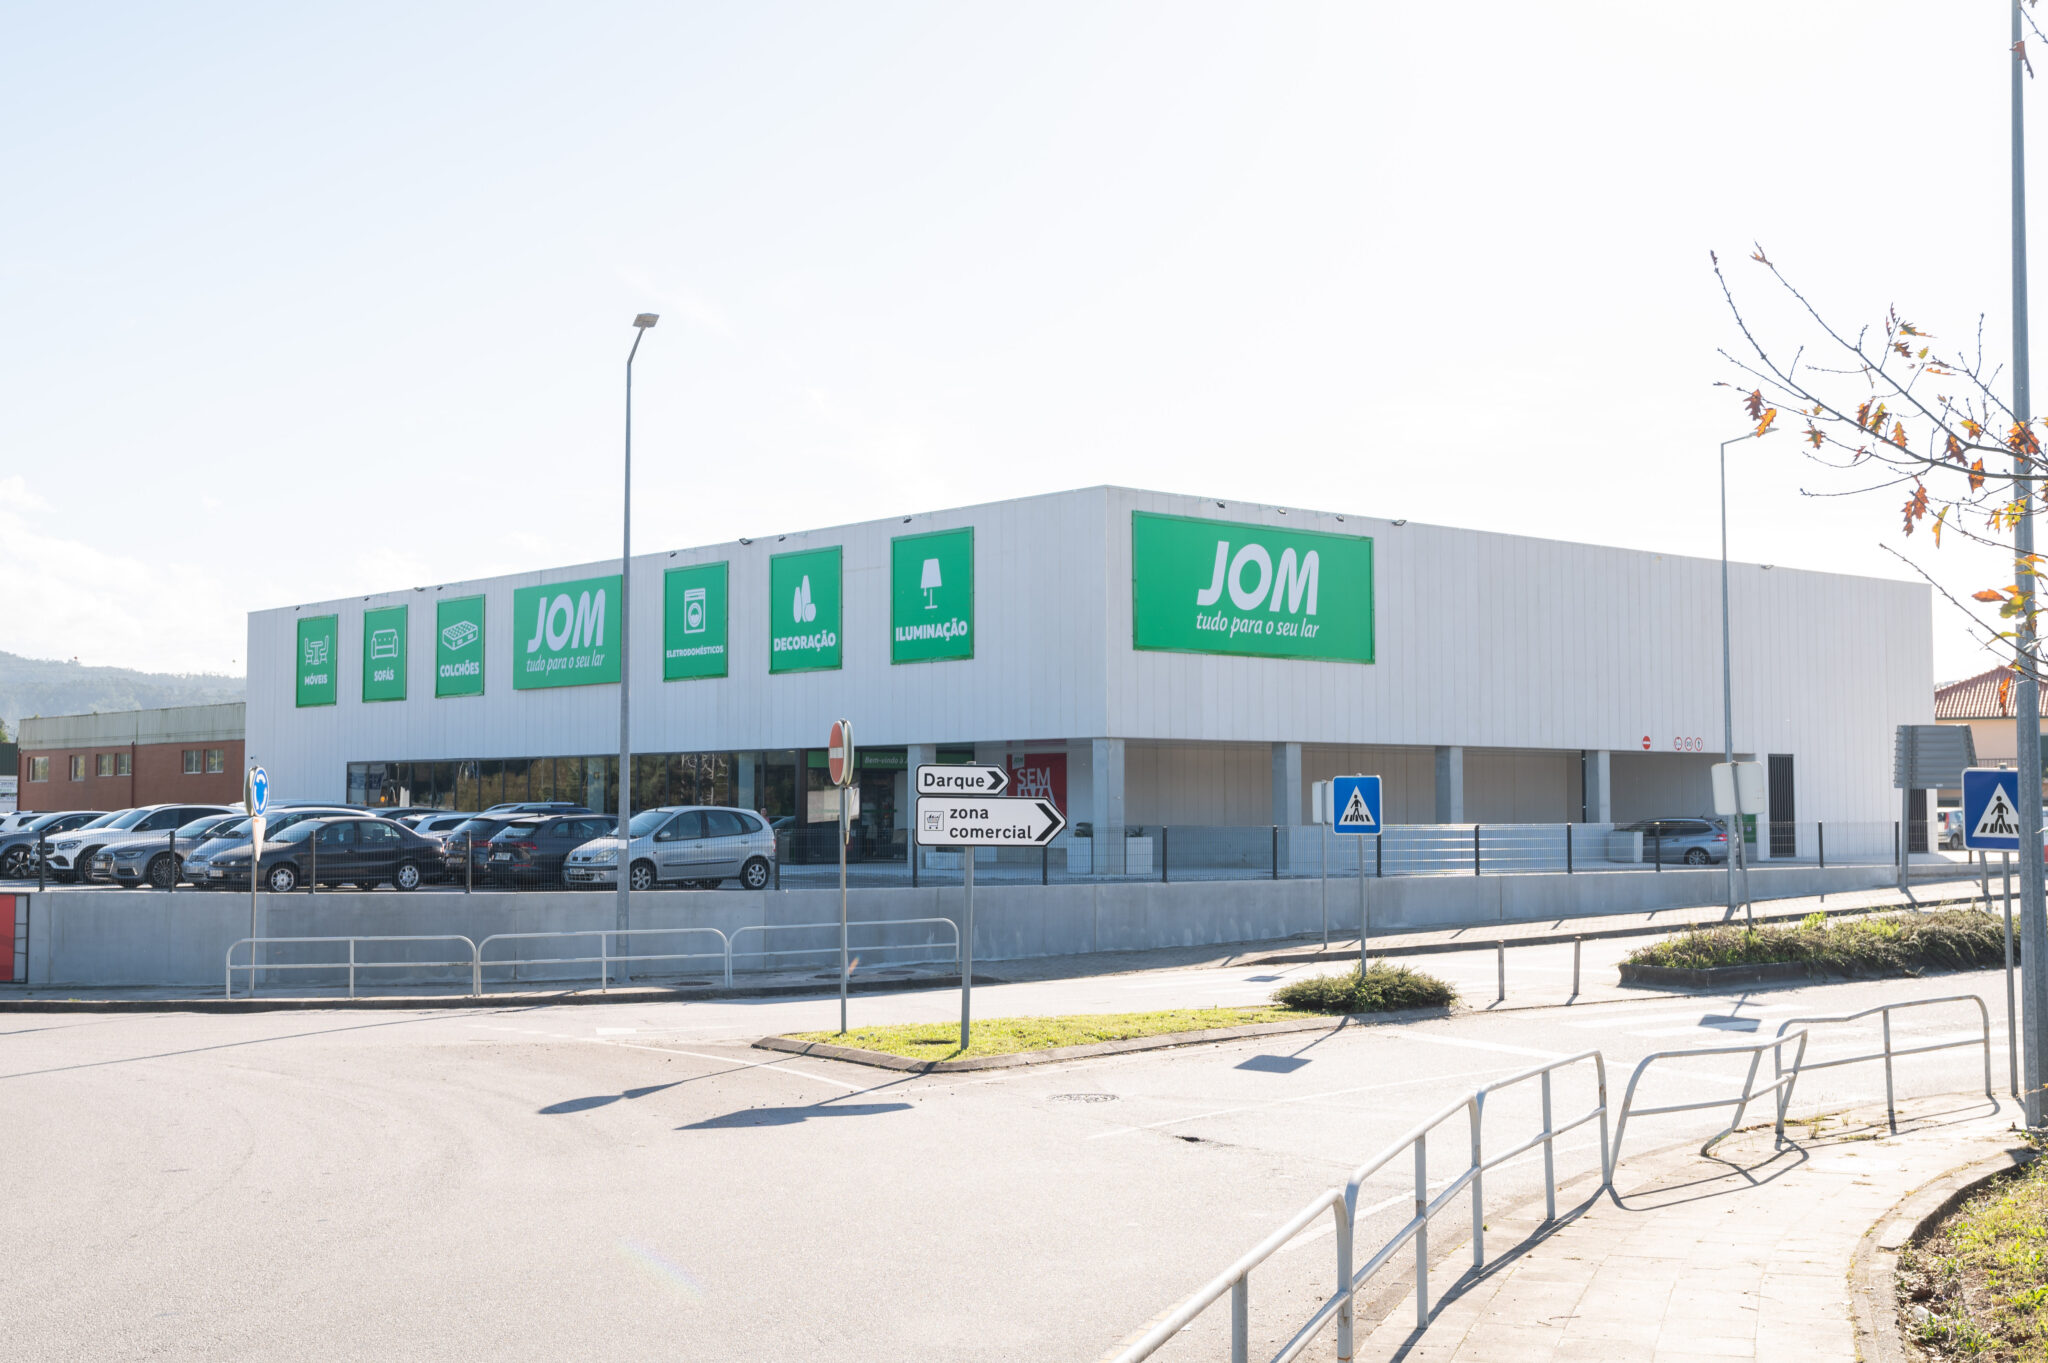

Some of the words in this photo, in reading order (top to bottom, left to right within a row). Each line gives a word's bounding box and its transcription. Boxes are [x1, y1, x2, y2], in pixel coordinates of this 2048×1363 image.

[1196, 541, 1320, 616] JOM
[526, 589, 606, 653] JOM
[895, 617, 968, 641] ILUMINAÇÃO
[1196, 610, 1228, 631] tudo
[1229, 617, 1263, 639] para
[1265, 620, 1275, 635] o
[1276, 622, 1299, 637] seu
[1300, 617, 1320, 638] lar
[773, 629, 837, 652] DECORAÇÃO
[666, 644, 724, 658] ELETRODOMÉSTICOS
[439, 659, 480, 678] COLCHÕES
[526, 654, 546, 672] tudo
[545, 656, 567, 676] para
[568, 656, 575, 669] o
[575, 655, 590, 668] seu
[591, 649, 606, 667] lar
[304, 672, 328, 686] MÓVEIS
[373, 667, 395, 682] SOFÁS
[864, 755, 899, 764] Bem-vindo
[923, 772, 985, 789] Darque
[1017, 767, 1050, 787] SEM
[949, 808, 989, 819] zona
[949, 825, 1032, 839] comercial
